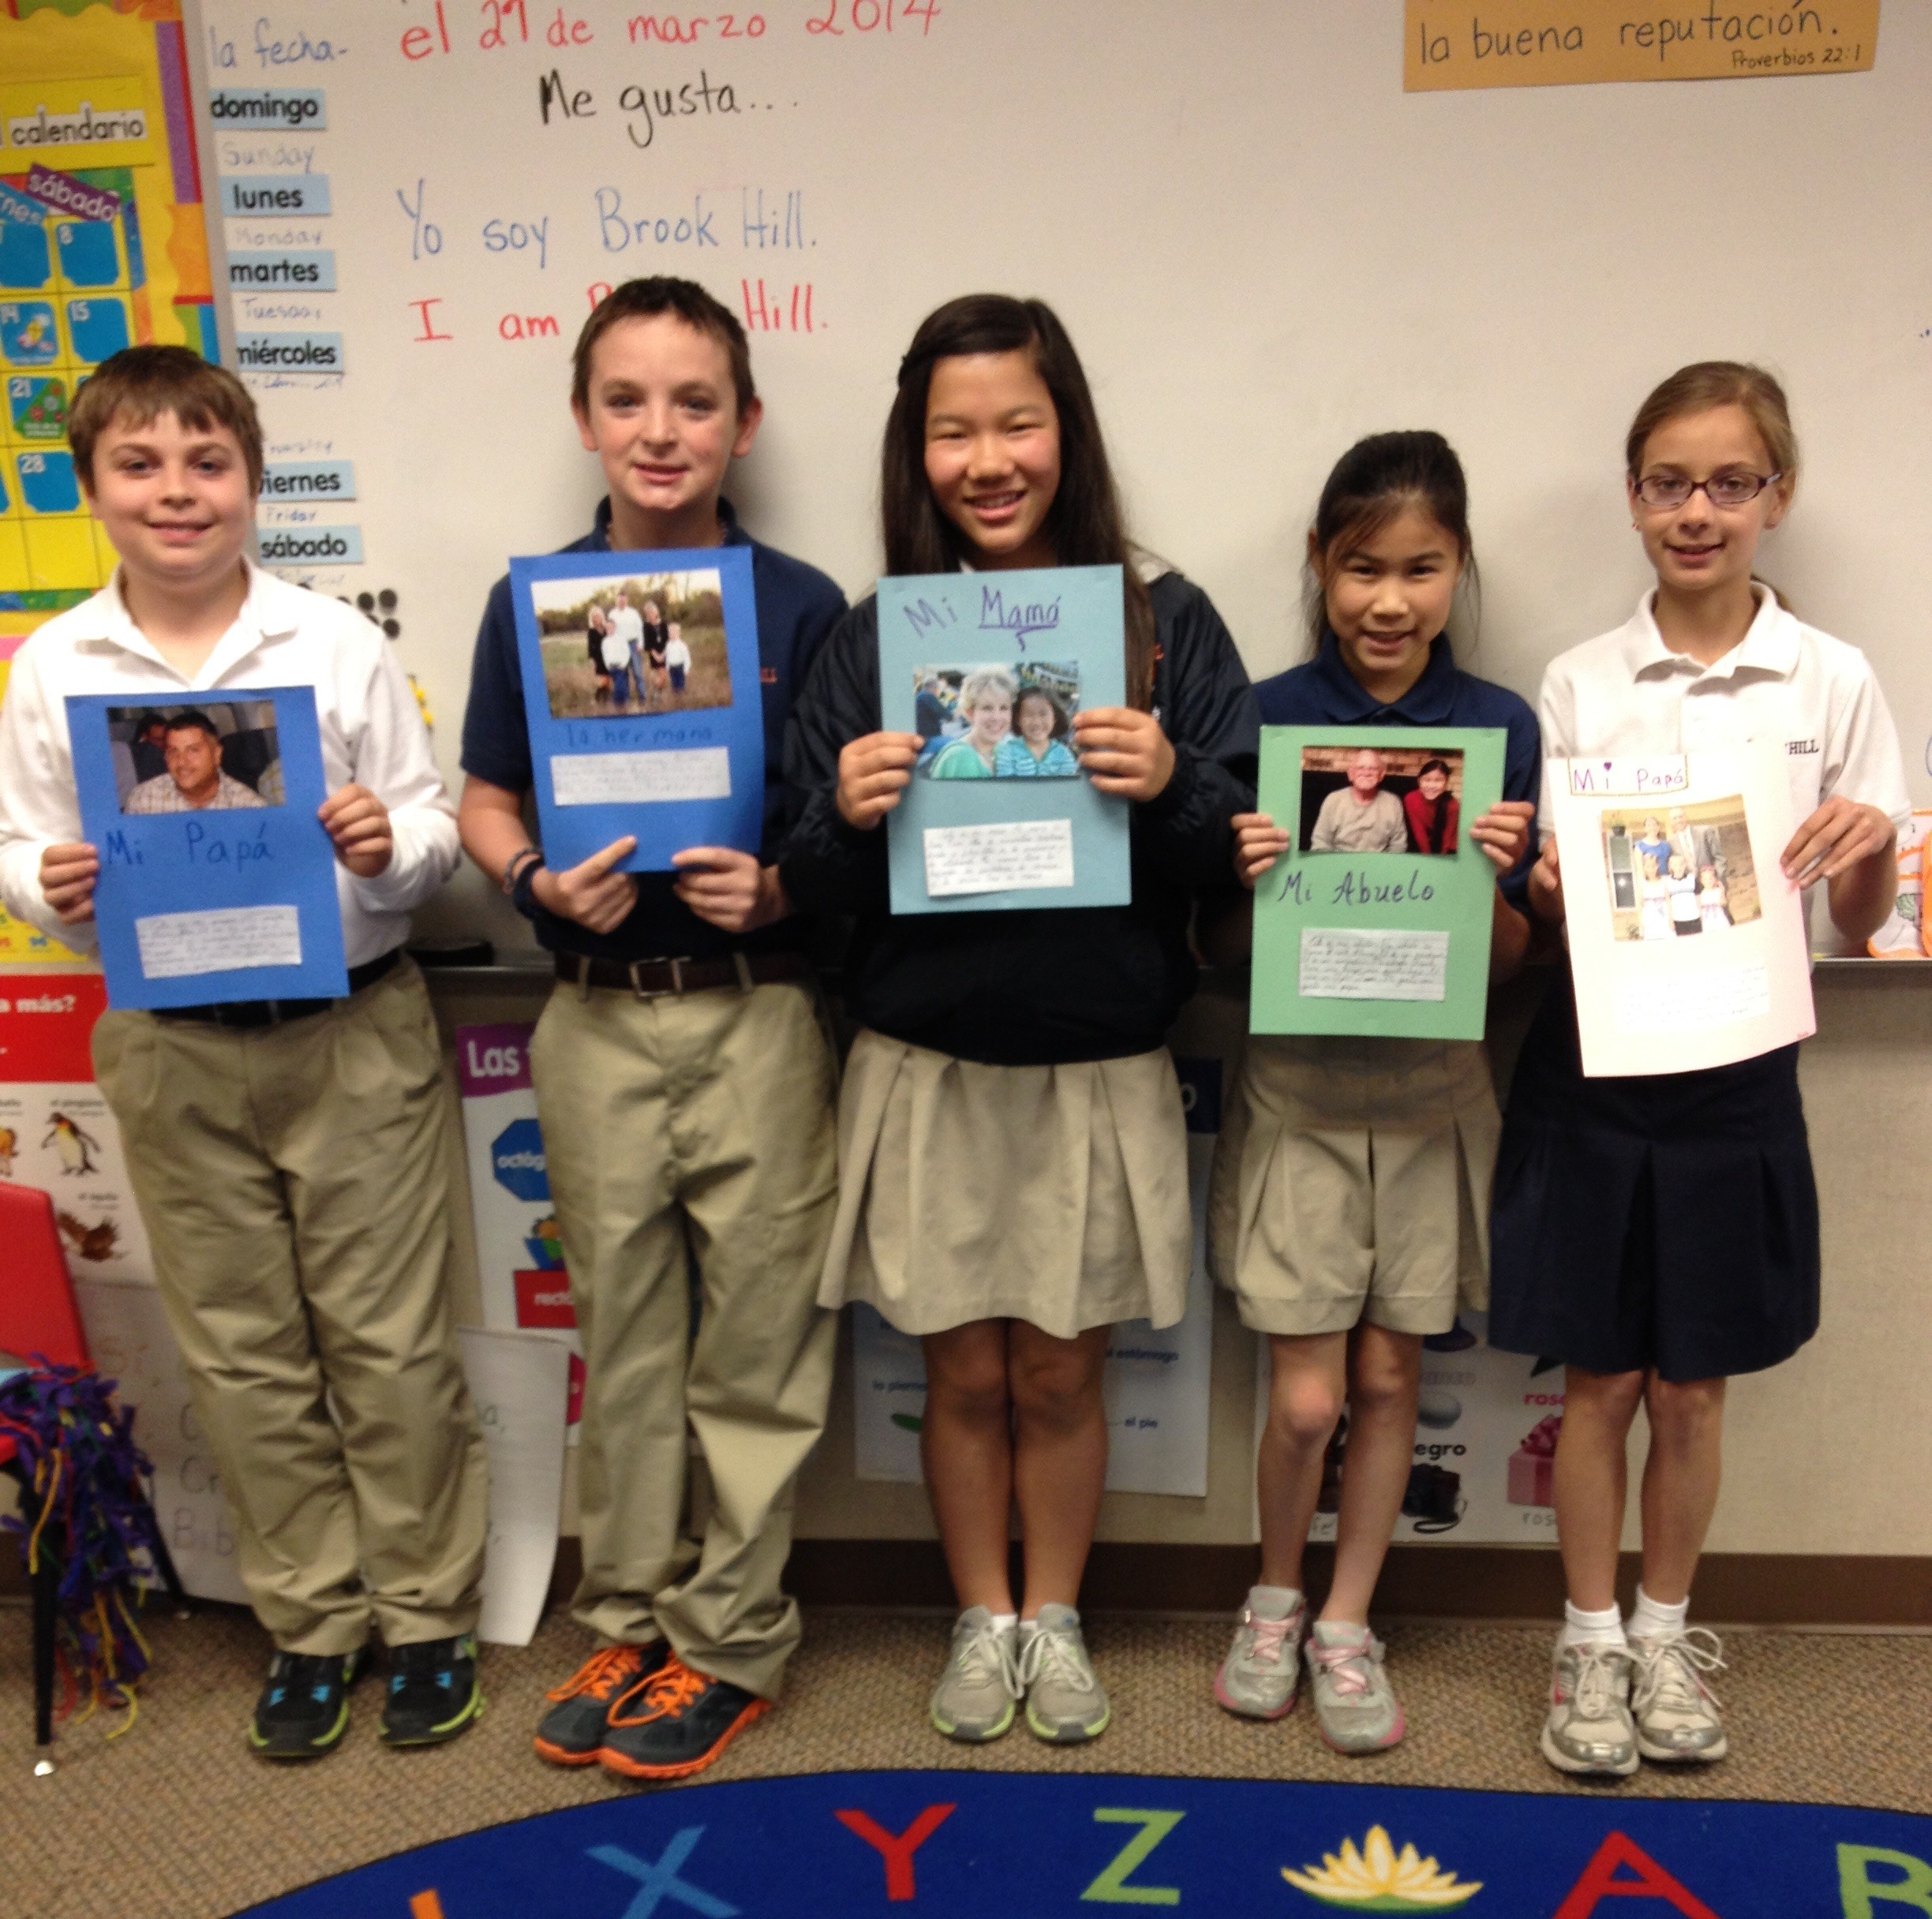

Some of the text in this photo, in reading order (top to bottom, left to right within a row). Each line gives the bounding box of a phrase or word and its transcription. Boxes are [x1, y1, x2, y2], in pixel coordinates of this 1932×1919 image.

[208, 25, 238, 68] la
[399, 0, 451, 62] el
[545, 7, 595, 48] de
[627, 10, 767, 46] marzo
[1420, 0, 1840, 65] la buena reputación.
[1732, 43, 1861, 69] Proverbios 22:1
[210, 91, 318, 125] domingo
[539, 69, 597, 125] Me
[11, 107, 144, 145] calendario
[28, 174, 114, 222] sábado
[232, 183, 304, 210] lunes
[396, 178, 444, 261] Yo
[481, 216, 549, 269] soy
[593, 185, 721, 253] Brook
[229, 258, 320, 283] martes
[407, 298, 454, 342] I
[497, 312, 561, 342] am
[261, 533, 347, 559] sábado
[903, 585, 1062, 639] Mi Mamá
[1788, 739, 1820, 756] HILL
[1574, 761, 1683, 792] Mi Papá
[105, 821, 275, 873] Mi Papá
[1277, 869, 1436, 906] Mi Abuelo
[466, 1040, 521, 1079] Las
[1413, 1442, 1467, 1461] egro
[1522, 1513, 1557, 1526] ros
[585, 1802, 1187, 1919] X Y Z
[1551, 1830, 1728, 1919] A
